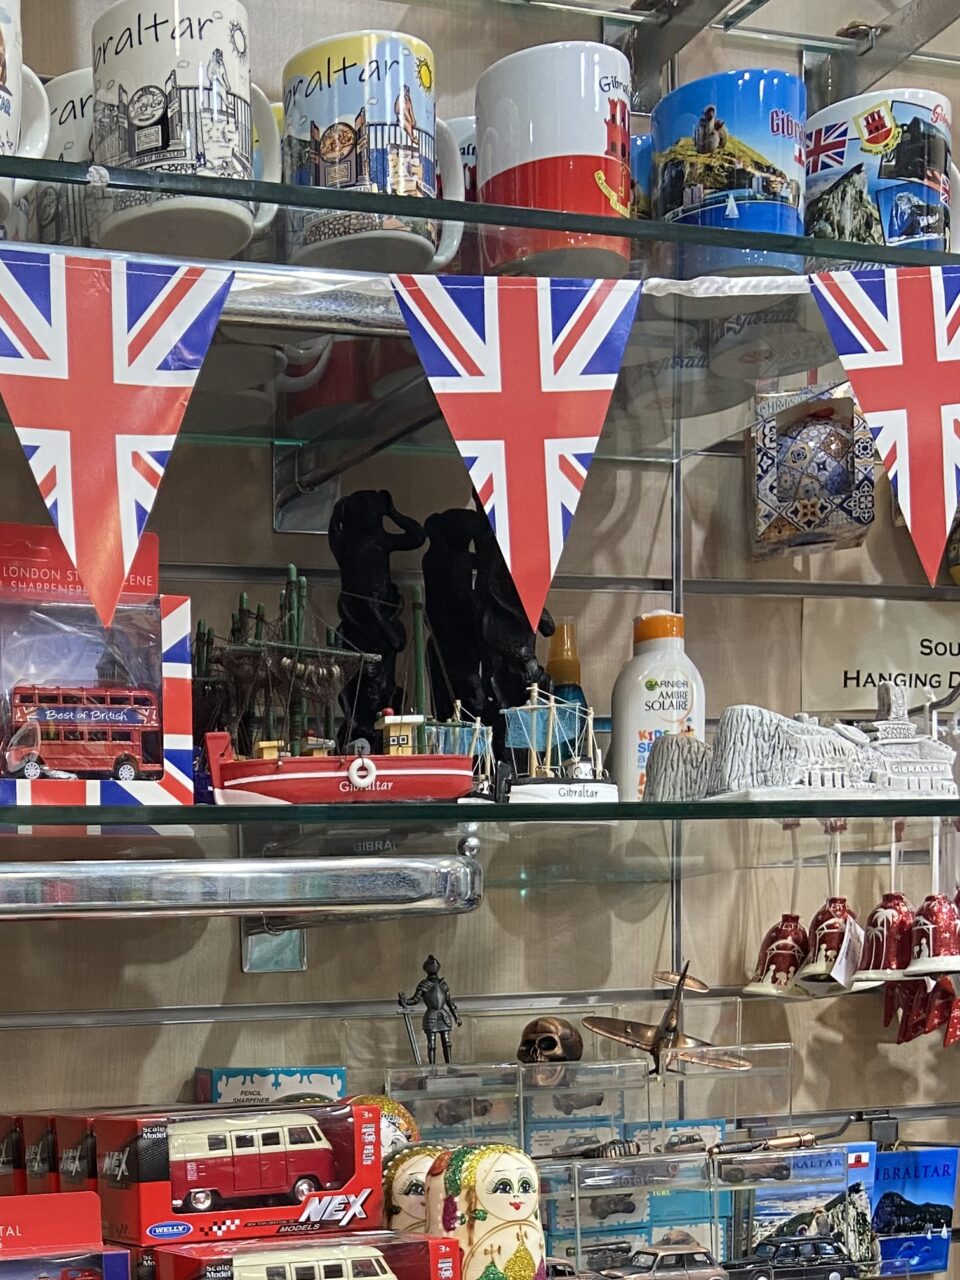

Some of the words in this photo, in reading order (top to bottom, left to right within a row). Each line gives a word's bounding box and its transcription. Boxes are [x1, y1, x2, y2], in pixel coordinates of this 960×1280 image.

[3, 566, 60, 580] LONDON
[645, 680, 688, 689] GARNIER
[843, 670, 941, 689] HANGING
[658, 691, 688, 700] AMBRE
[645, 700, 688, 712] SOLAIRE
[45, 709, 74, 721] Best
[76, 710, 88, 721] of
[90, 710, 128, 722] British
[892, 764, 945, 773] GIBRALTAR
[558, 785, 598, 798] Gibraltar
[362, 1111, 373, 1119] 3+
[103, 1147, 128, 1181] NEX
[876, 1163, 951, 1181] IBRALTAR
[299, 1188, 372, 1226] NEX
[154, 1225, 185, 1234] WELLY
[280, 1223, 320, 1232] MODELS
